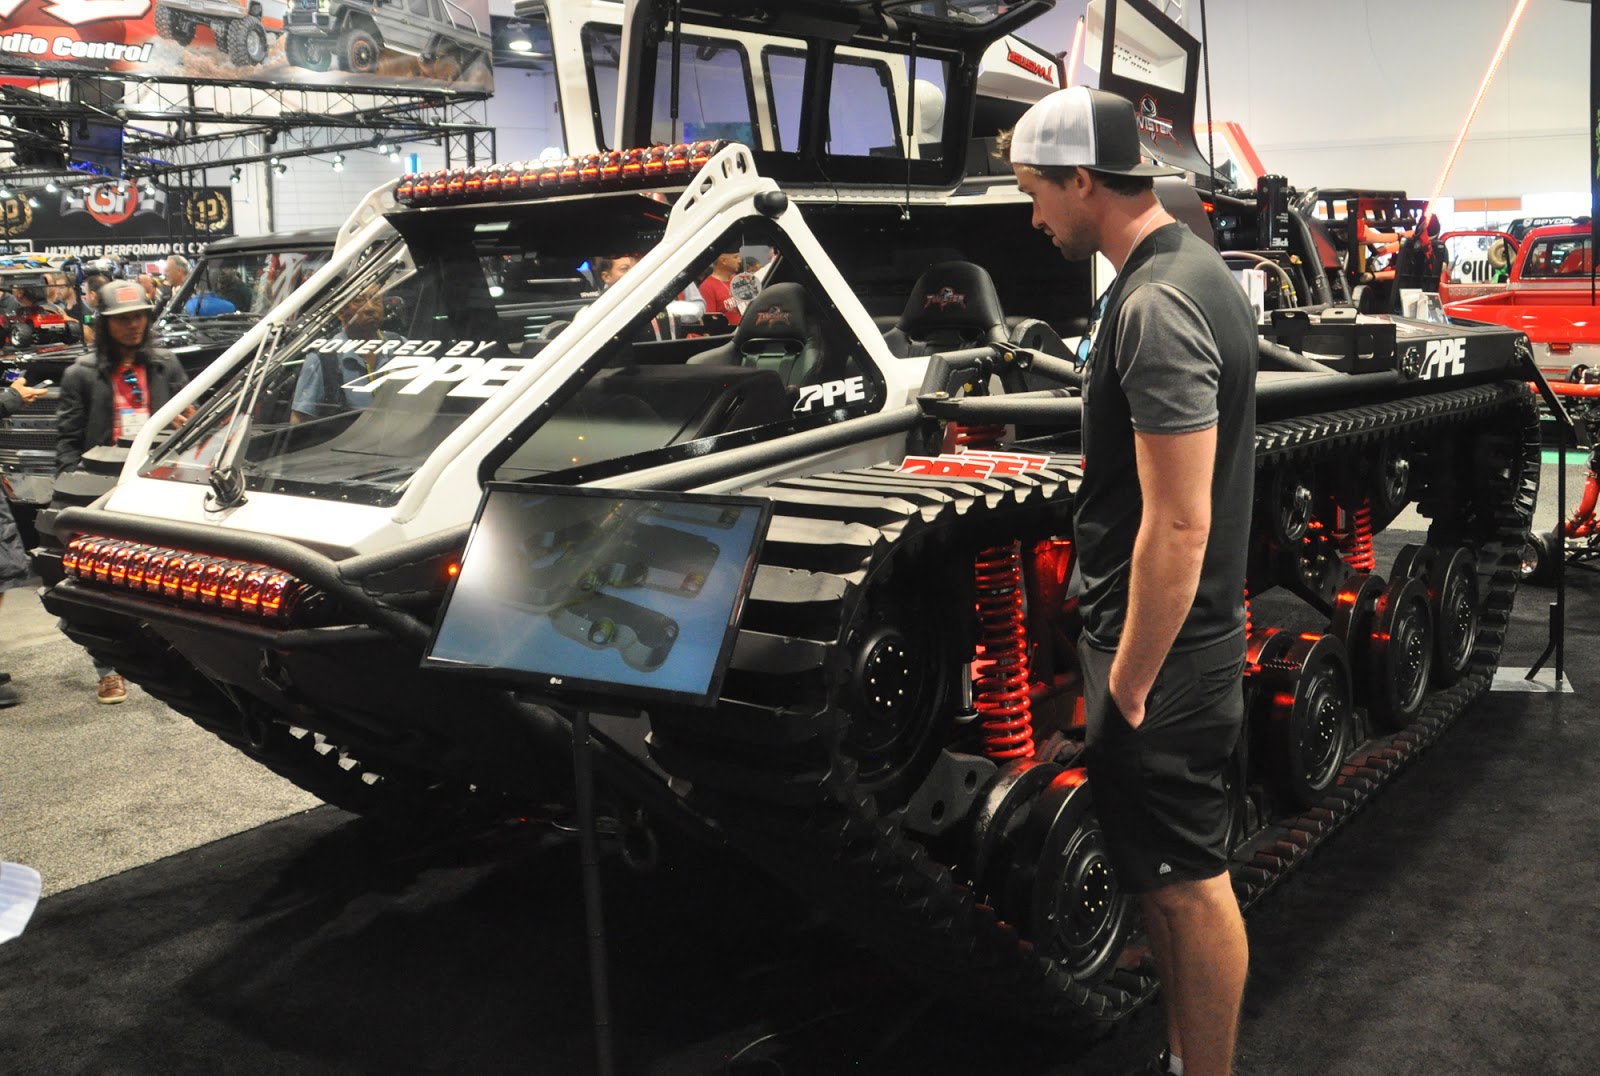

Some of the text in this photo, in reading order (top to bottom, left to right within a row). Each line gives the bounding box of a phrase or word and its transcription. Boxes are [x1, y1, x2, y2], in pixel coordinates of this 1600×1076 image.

[0, 32, 153, 62] dio Control
[1004, 39, 1054, 85] TWISTER
[45, 244, 103, 256] ULTIMATE
[302, 338, 497, 356] POWERED BY
[1418, 337, 1466, 381] PPE
[340, 355, 534, 398] PPE
[793, 375, 866, 412] PPE
